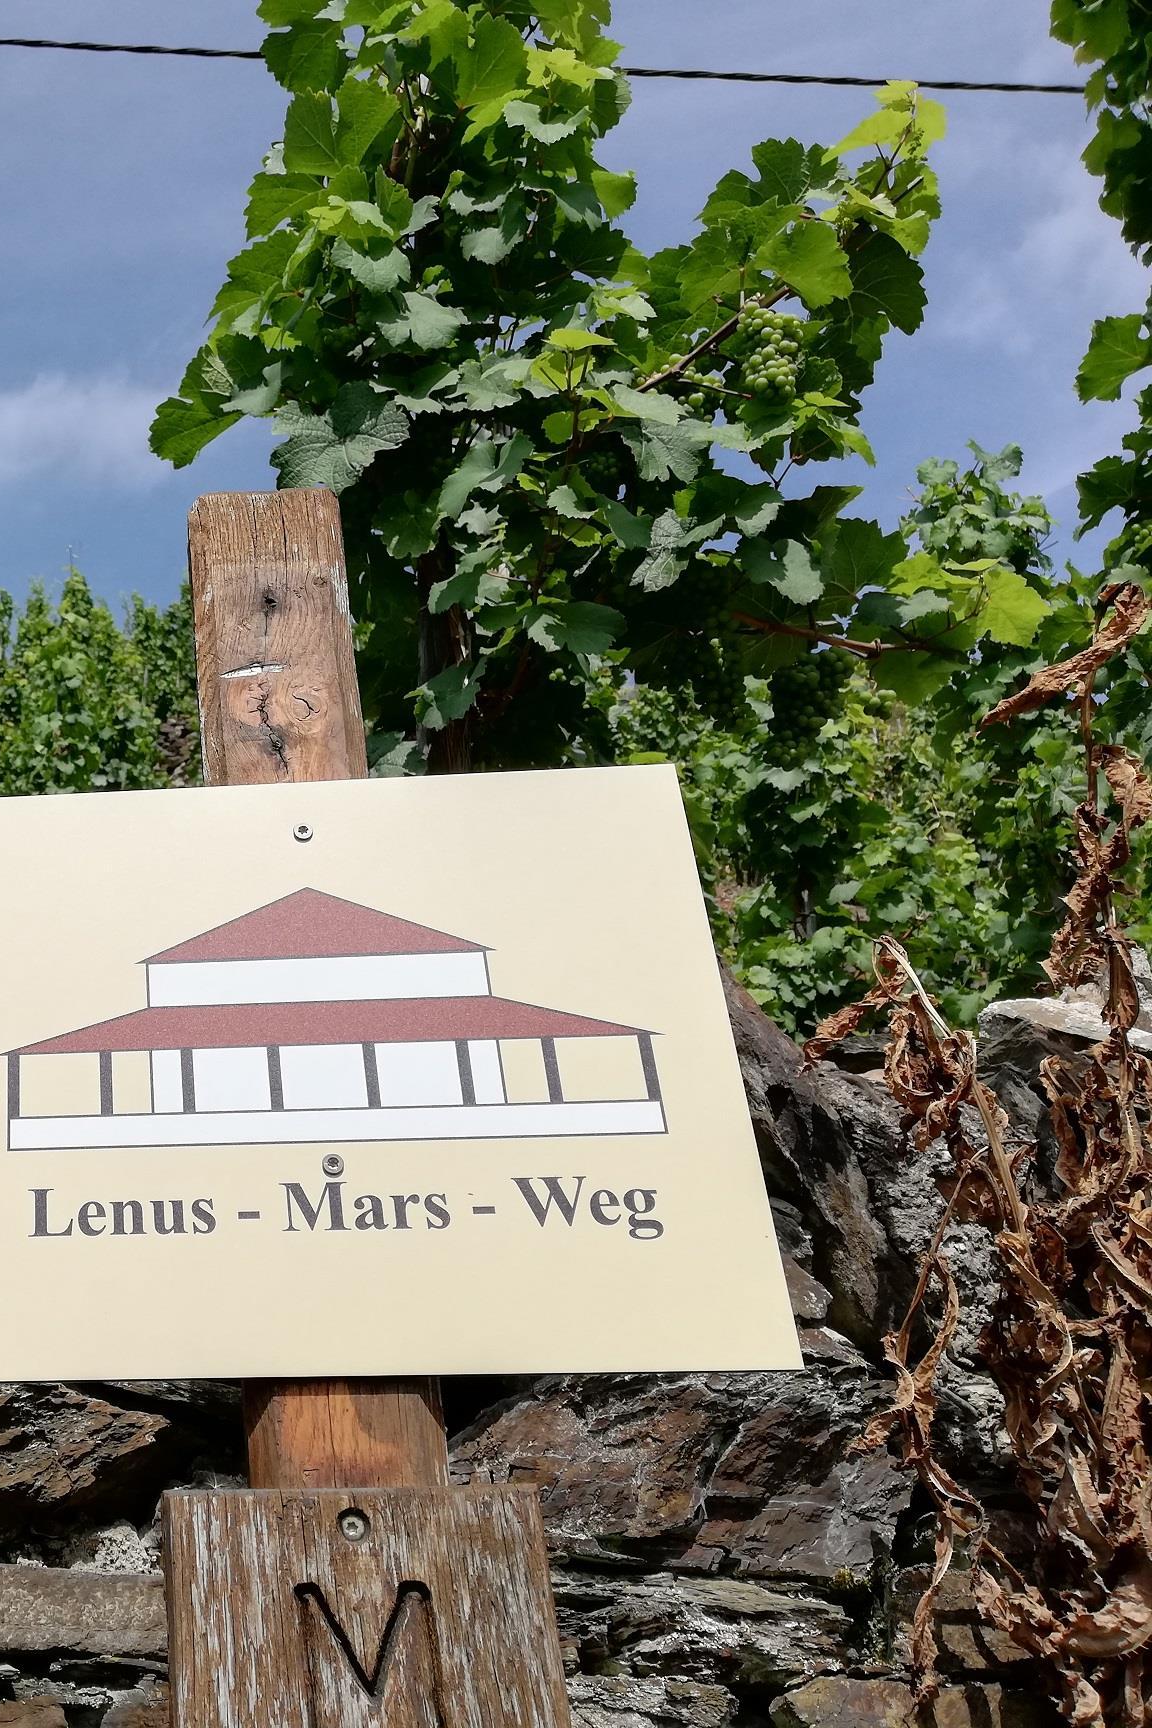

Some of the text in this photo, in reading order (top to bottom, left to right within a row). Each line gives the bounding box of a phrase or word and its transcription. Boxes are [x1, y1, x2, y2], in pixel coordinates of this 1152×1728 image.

[28, 1187, 218, 1238] Lenus
[280, 1180, 451, 1232] Mars
[511, 1175, 665, 1240] Weg
